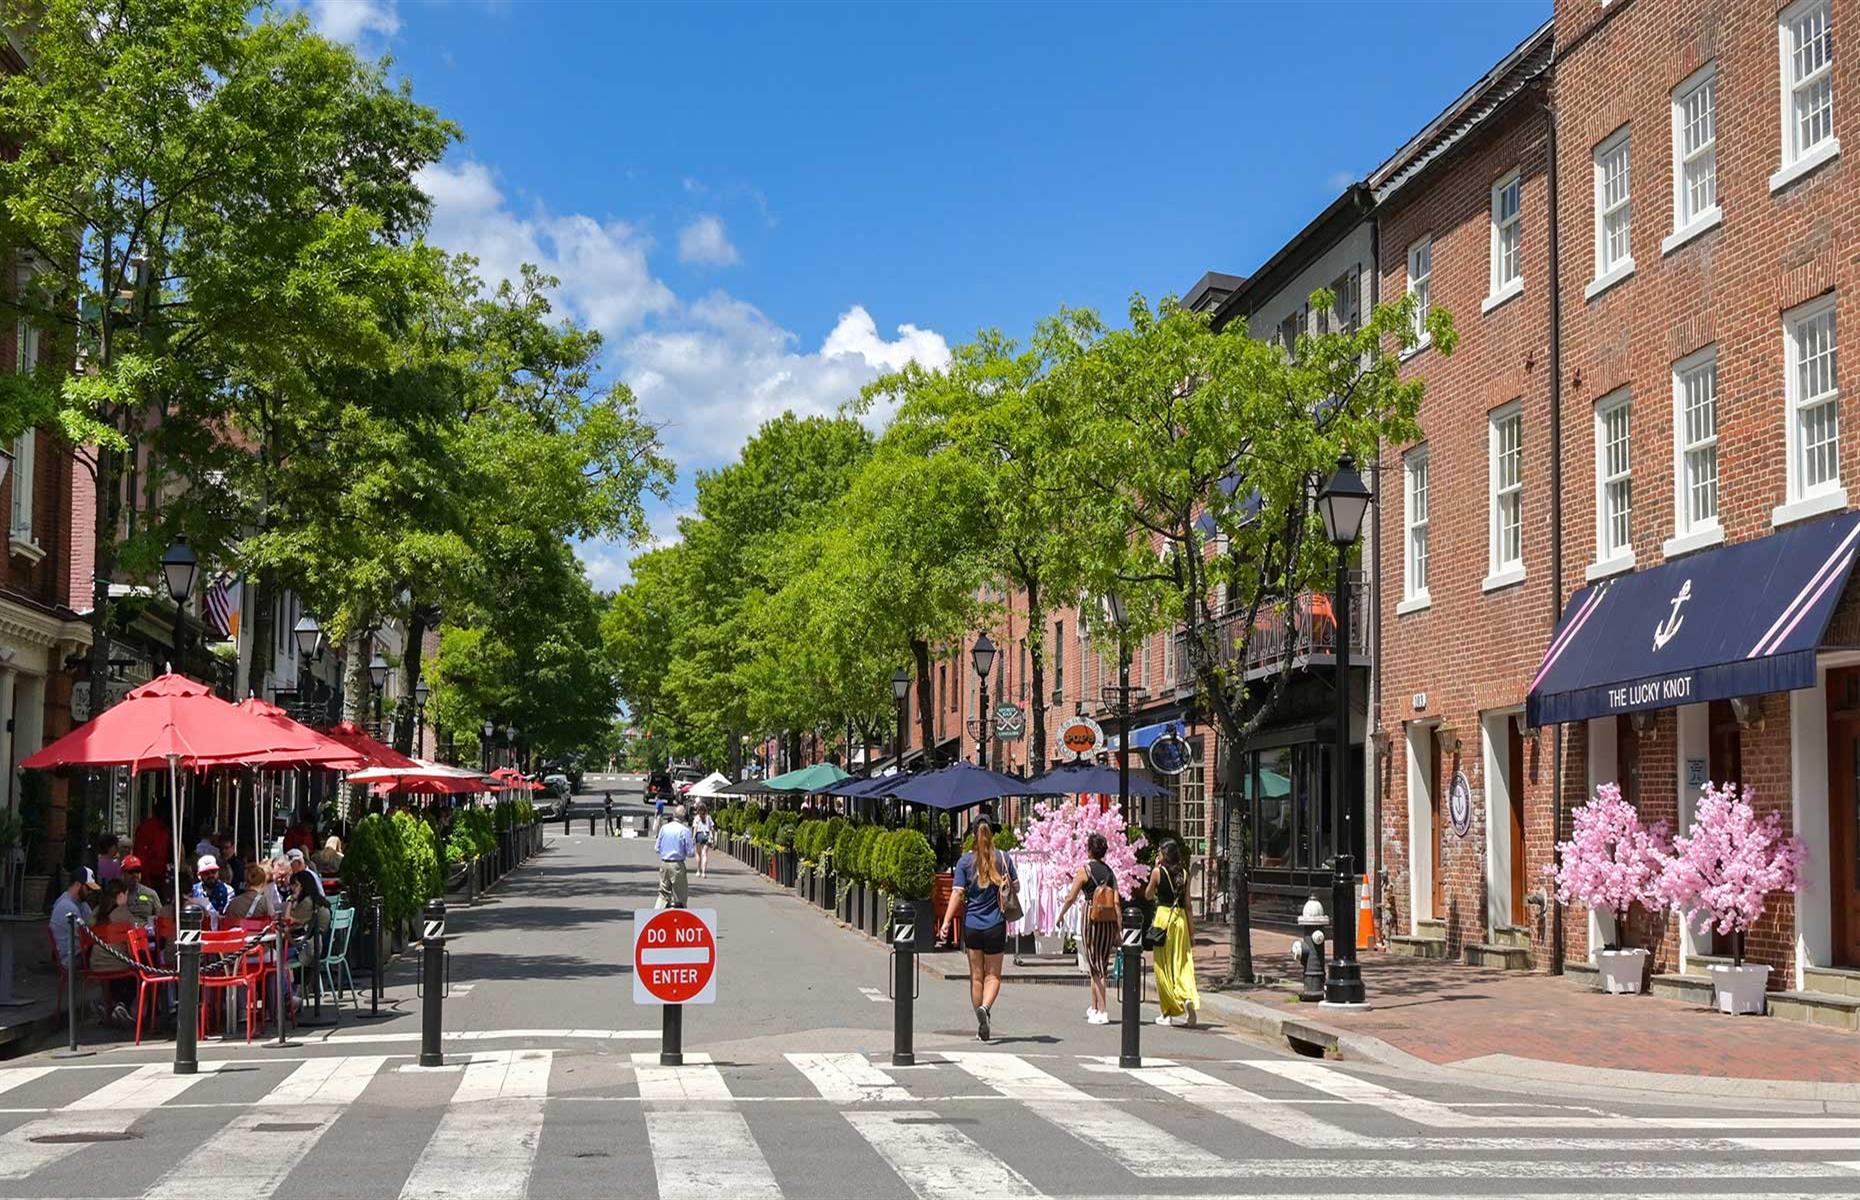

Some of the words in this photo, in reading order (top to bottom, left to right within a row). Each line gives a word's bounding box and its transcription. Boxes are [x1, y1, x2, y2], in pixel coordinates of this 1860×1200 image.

[1608, 689, 1627, 708] THE
[1630, 682, 1660, 705] LUCKY
[1663, 677, 1691, 699] KNOT
[648, 928, 667, 943] DO
[676, 928, 703, 942] NOT
[653, 969, 698, 984] ENTER
